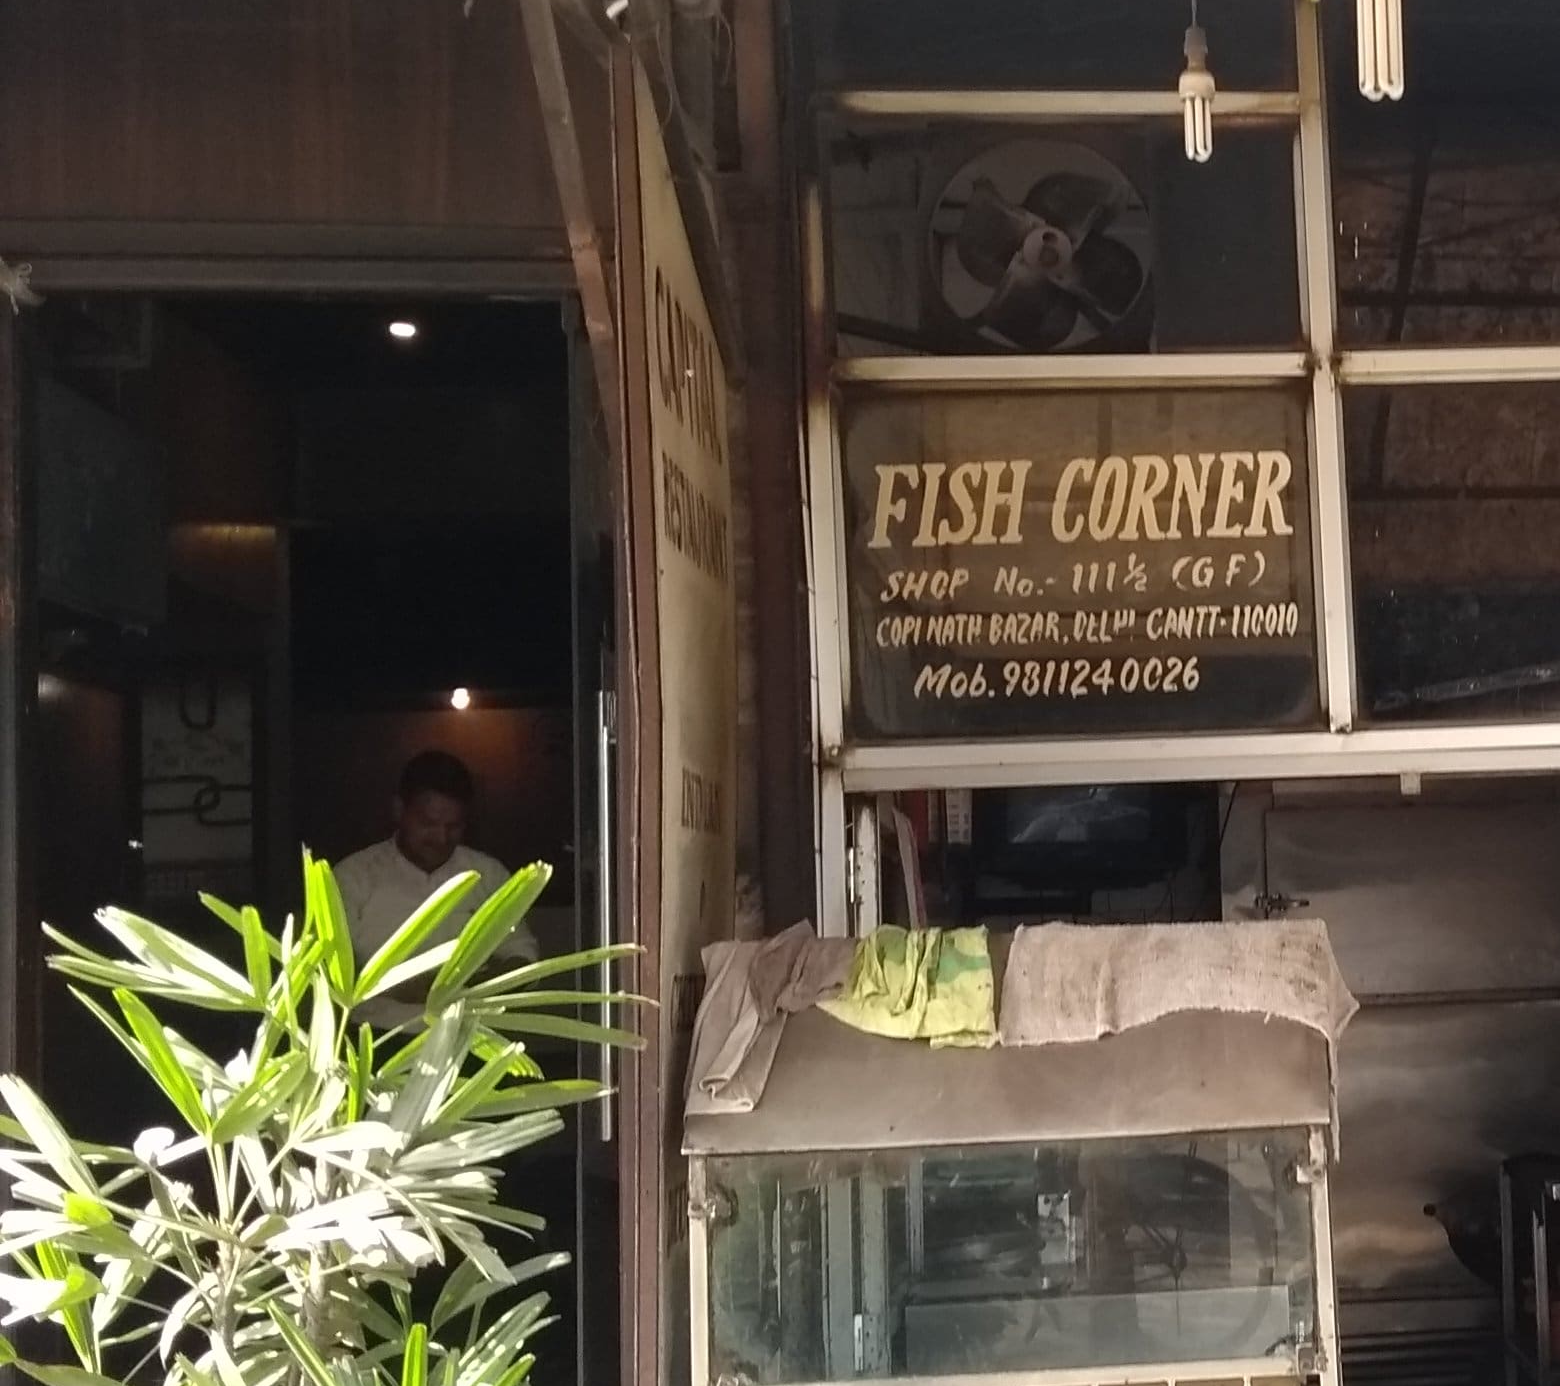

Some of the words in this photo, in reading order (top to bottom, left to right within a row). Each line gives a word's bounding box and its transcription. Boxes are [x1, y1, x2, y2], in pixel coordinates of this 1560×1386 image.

[867, 460, 1033, 549] FISH
[1051, 450, 1295, 544] CORNER
[880, 568, 969, 603] SHOP
[927, 614, 982, 645] NATH
